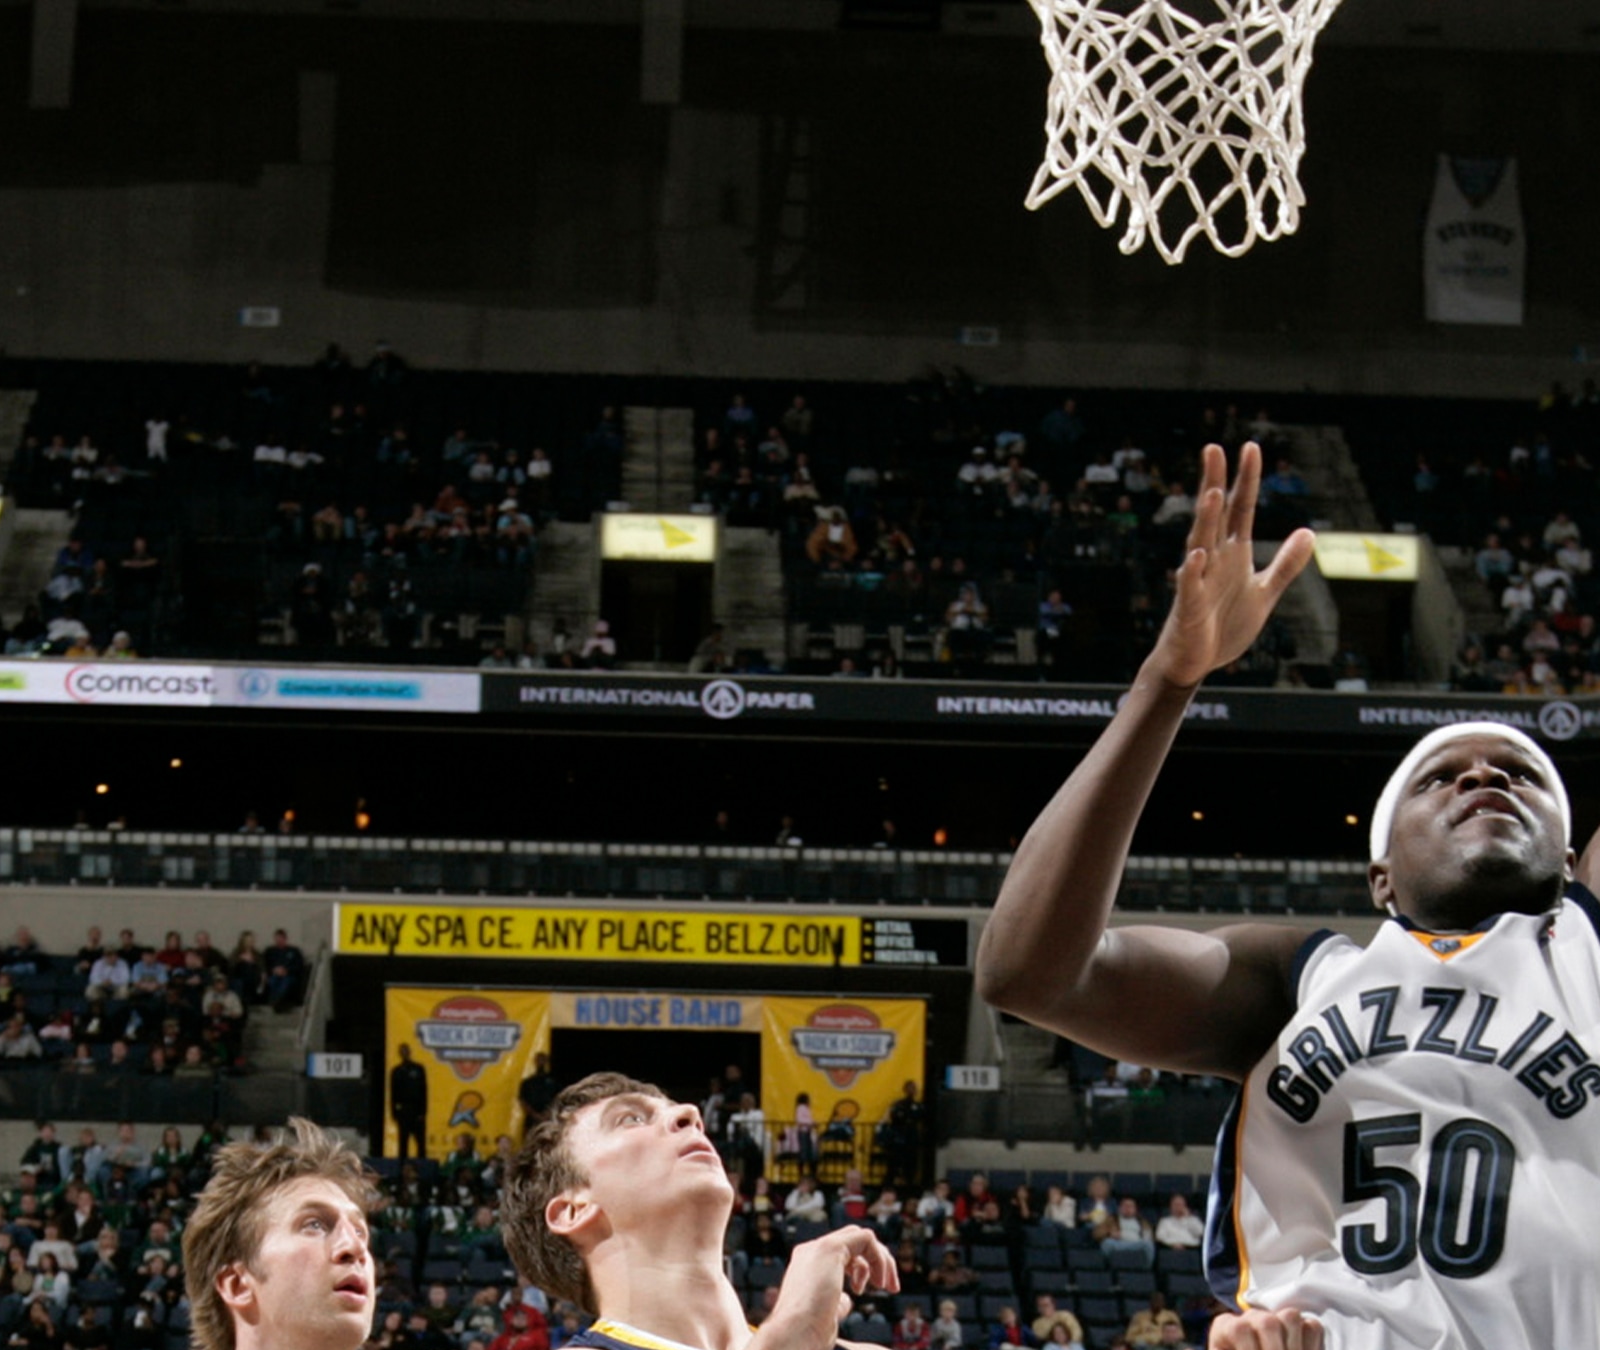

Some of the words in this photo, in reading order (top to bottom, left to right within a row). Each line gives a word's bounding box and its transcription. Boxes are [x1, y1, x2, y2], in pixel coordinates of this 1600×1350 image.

[520, 685, 700, 708] INTERNATIONAL
[746, 692, 815, 710] PAPER
[937, 696, 1116, 718] INTERNATIONAL
[1186, 702, 1229, 721] PER
[1359, 707, 1536, 730] INTERNATIONAL
[351, 912, 407, 947] ANY
[532, 916, 589, 951] ANY
[597, 919, 695, 953] PLACE.
[704, 921, 846, 956] BELZ.COM
[575, 996, 661, 1026] HOUSE
[669, 997, 742, 1027] BAND
[324, 1058, 352, 1073] 101
[960, 1069, 990, 1086] 118
[1341, 1112, 1516, 1279] 50
